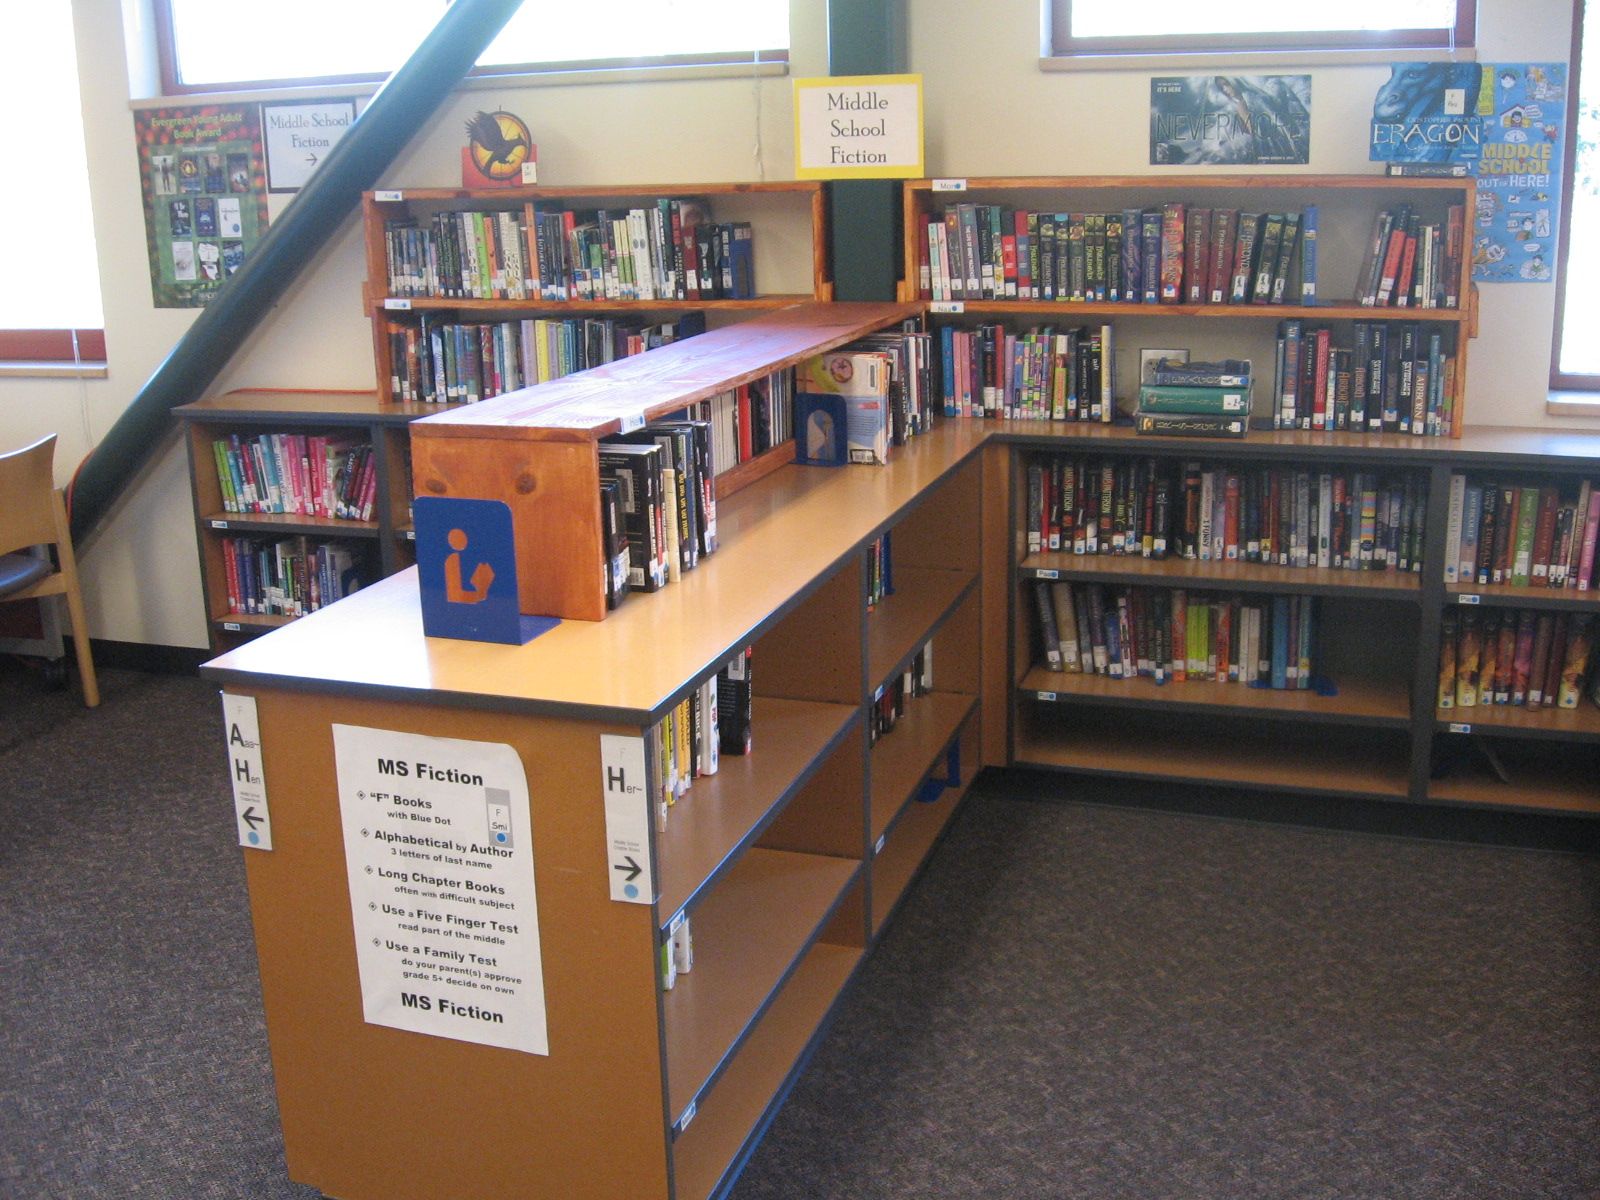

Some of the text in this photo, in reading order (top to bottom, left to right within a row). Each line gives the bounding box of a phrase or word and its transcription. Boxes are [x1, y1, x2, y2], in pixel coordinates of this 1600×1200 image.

[827, 91, 889, 111] Middle
[151, 117, 192, 129] Evergreen
[269, 112, 349, 130] Middle School
[830, 118, 886, 138] School
[1155, 111, 1305, 143] NEVERMORE
[195, 127, 222, 138] Award
[291, 134, 330, 149] Fiction
[1373, 122, 1481, 146] ERAGON
[830, 146, 887, 164] Fiction
[1481, 143, 1553, 160] MIDDLE
[1478, 159, 1550, 175] SCHOOL
[1476, 178, 1499, 188] OUT
[1509, 174, 1550, 187] HERE!
[1414, 375, 1425, 419] AIRBORN
[346, 452, 355, 473] CABOT
[1202, 525, 1210, 548] FUNNY
[377, 758, 483, 787] MS Fiction
[393, 794, 433, 810] Books
[495, 808, 502, 817] F
[387, 810, 452, 826] with Blue Dot
[491, 821, 508, 832] Smi
[374, 830, 514, 859] Alphabetical by Author
[391, 847, 493, 870] 3 letters of last name
[378, 866, 506, 895] Long Chapter Books
[394, 885, 516, 911] often with difficult subject
[382, 903, 520, 935] Use a Five Finger Test
[397, 921, 506, 946] read part of the middle
[385, 939, 498, 967] Use a Family Test
[401, 957, 523, 985] do your parent(s) approve
[402, 970, 515, 996] grade 5+ decide on own
[400, 991, 504, 1024] MS Fiction
